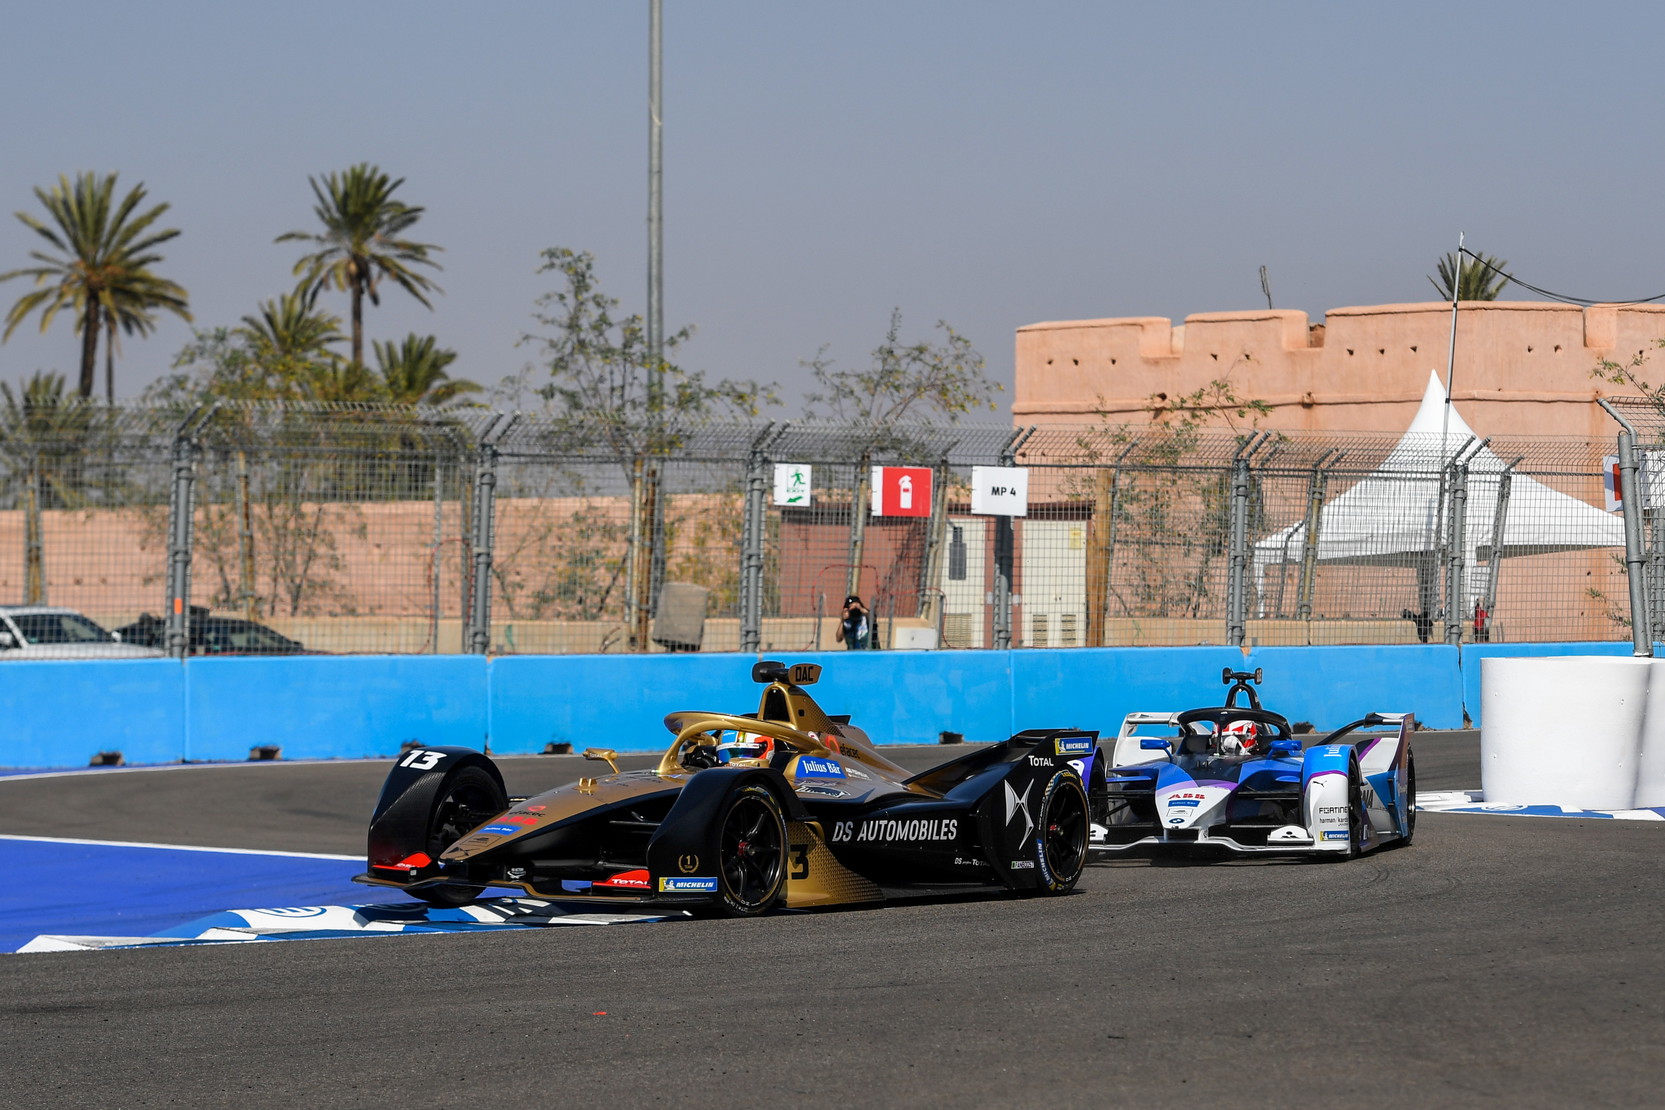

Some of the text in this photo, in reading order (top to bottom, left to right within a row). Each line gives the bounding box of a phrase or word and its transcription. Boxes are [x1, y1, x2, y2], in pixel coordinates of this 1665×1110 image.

[991, 486, 1016, 496] MP 4
[795, 666, 814, 682] DAC
[400, 749, 447, 770] 13
[802, 760, 827, 774] Julius
[826, 762, 841, 774] Bär
[1028, 755, 1054, 766] TOTAL
[832, 819, 957, 841] DS AUTOMOBILES
[784, 844, 809, 880] 3
